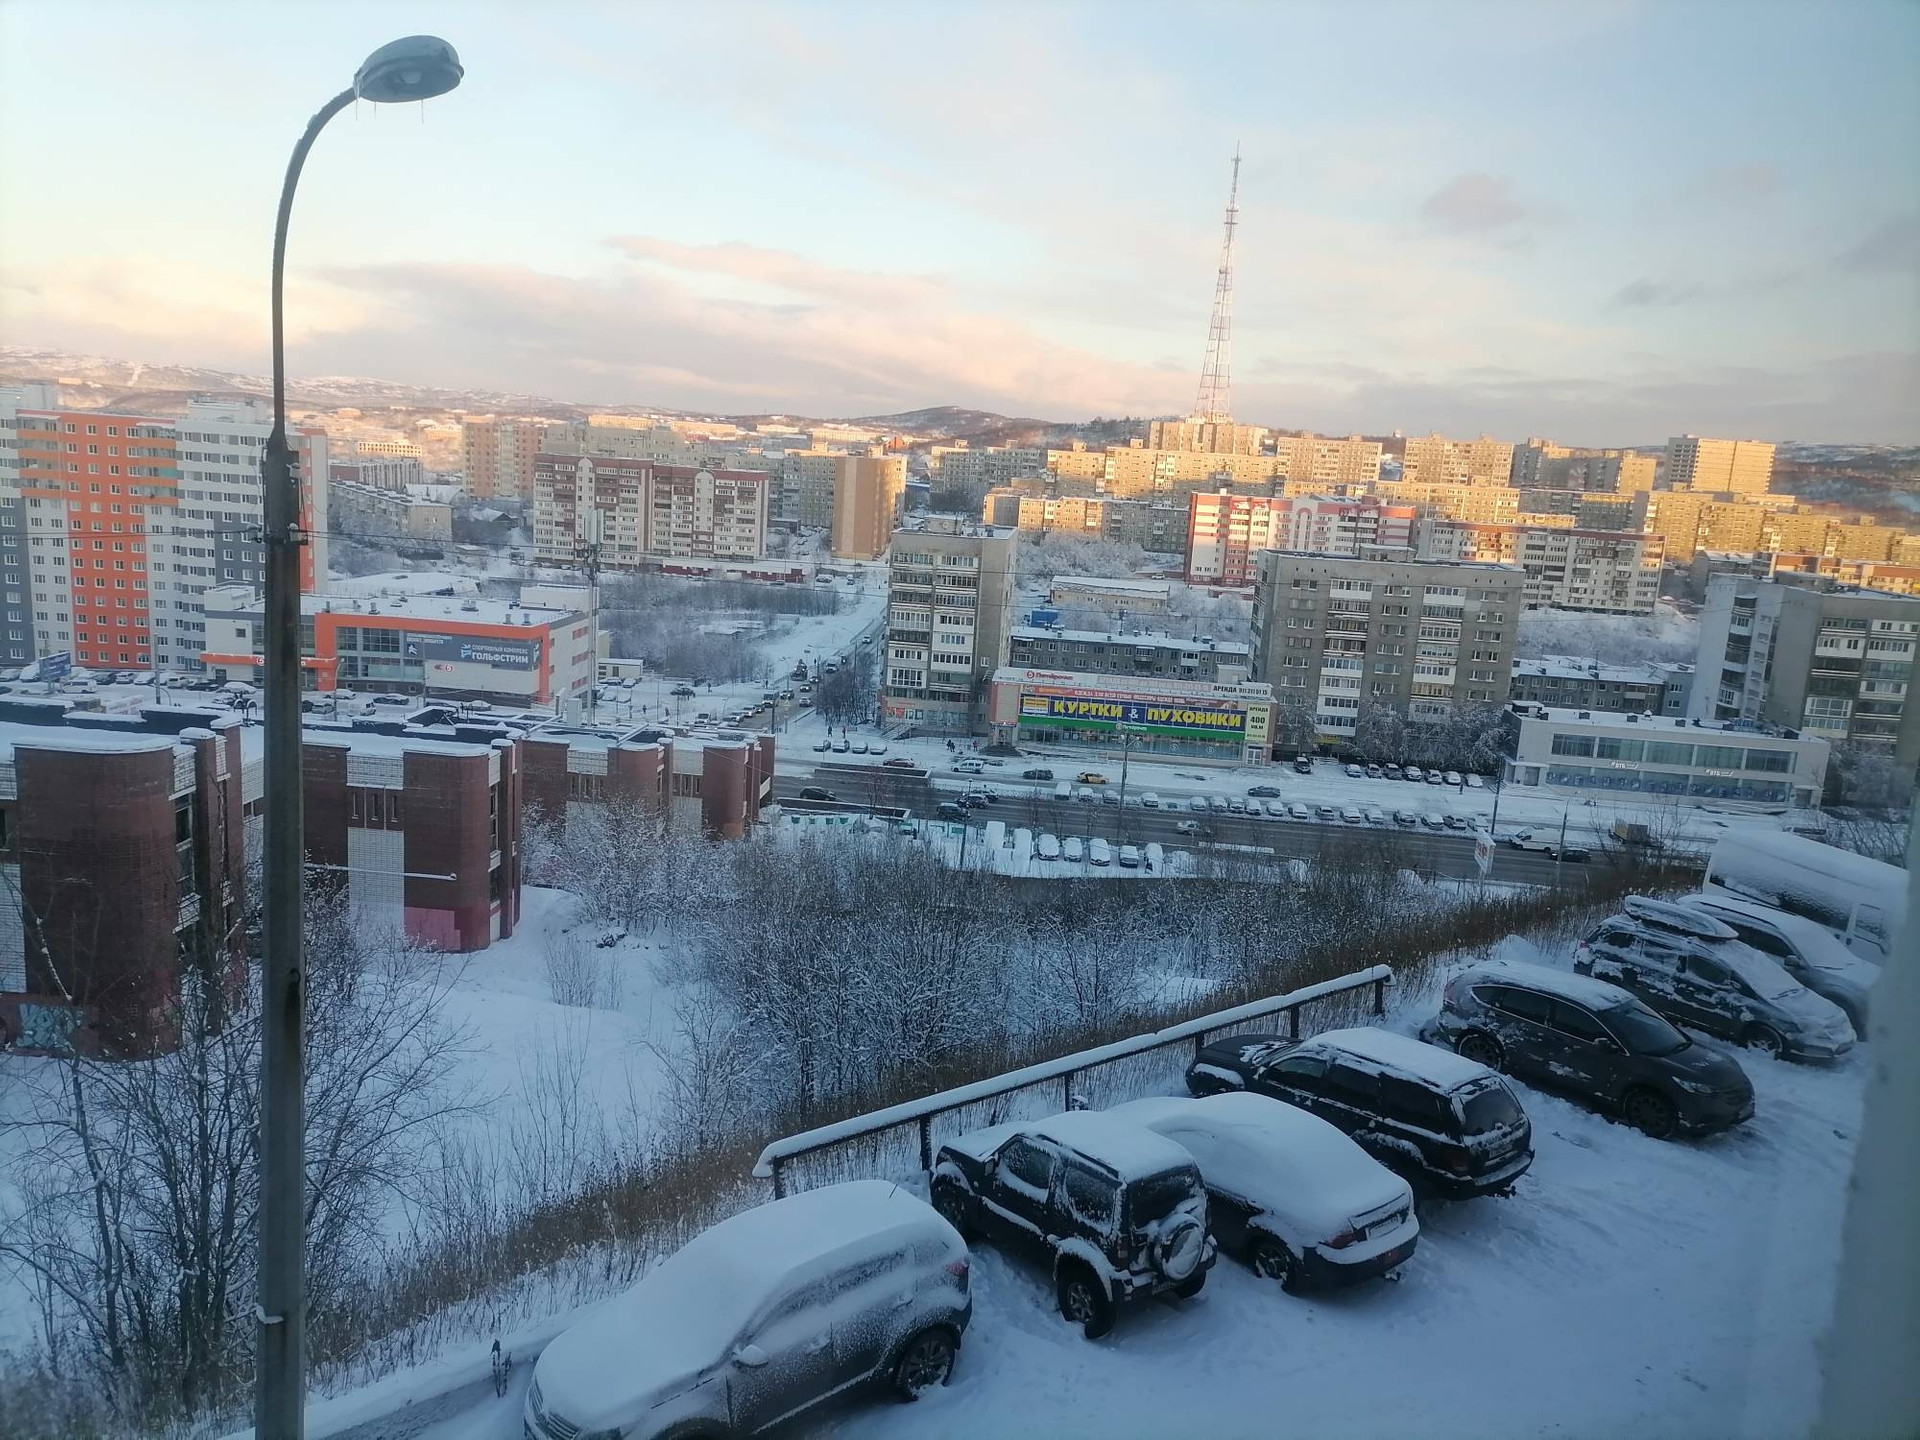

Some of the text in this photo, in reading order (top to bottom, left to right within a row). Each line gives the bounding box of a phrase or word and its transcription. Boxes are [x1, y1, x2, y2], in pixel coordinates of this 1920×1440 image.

[471, 652, 529, 664] ГОЛЬФСТРИМ
[1213, 685, 1237, 693] АРЕНДА
[1054, 700, 1122, 717] КУРТКИ
[1128, 708, 1139, 719] &
[1147, 708, 1241, 726] ПУХОВИКИ
[1250, 716, 1266, 724] 400
